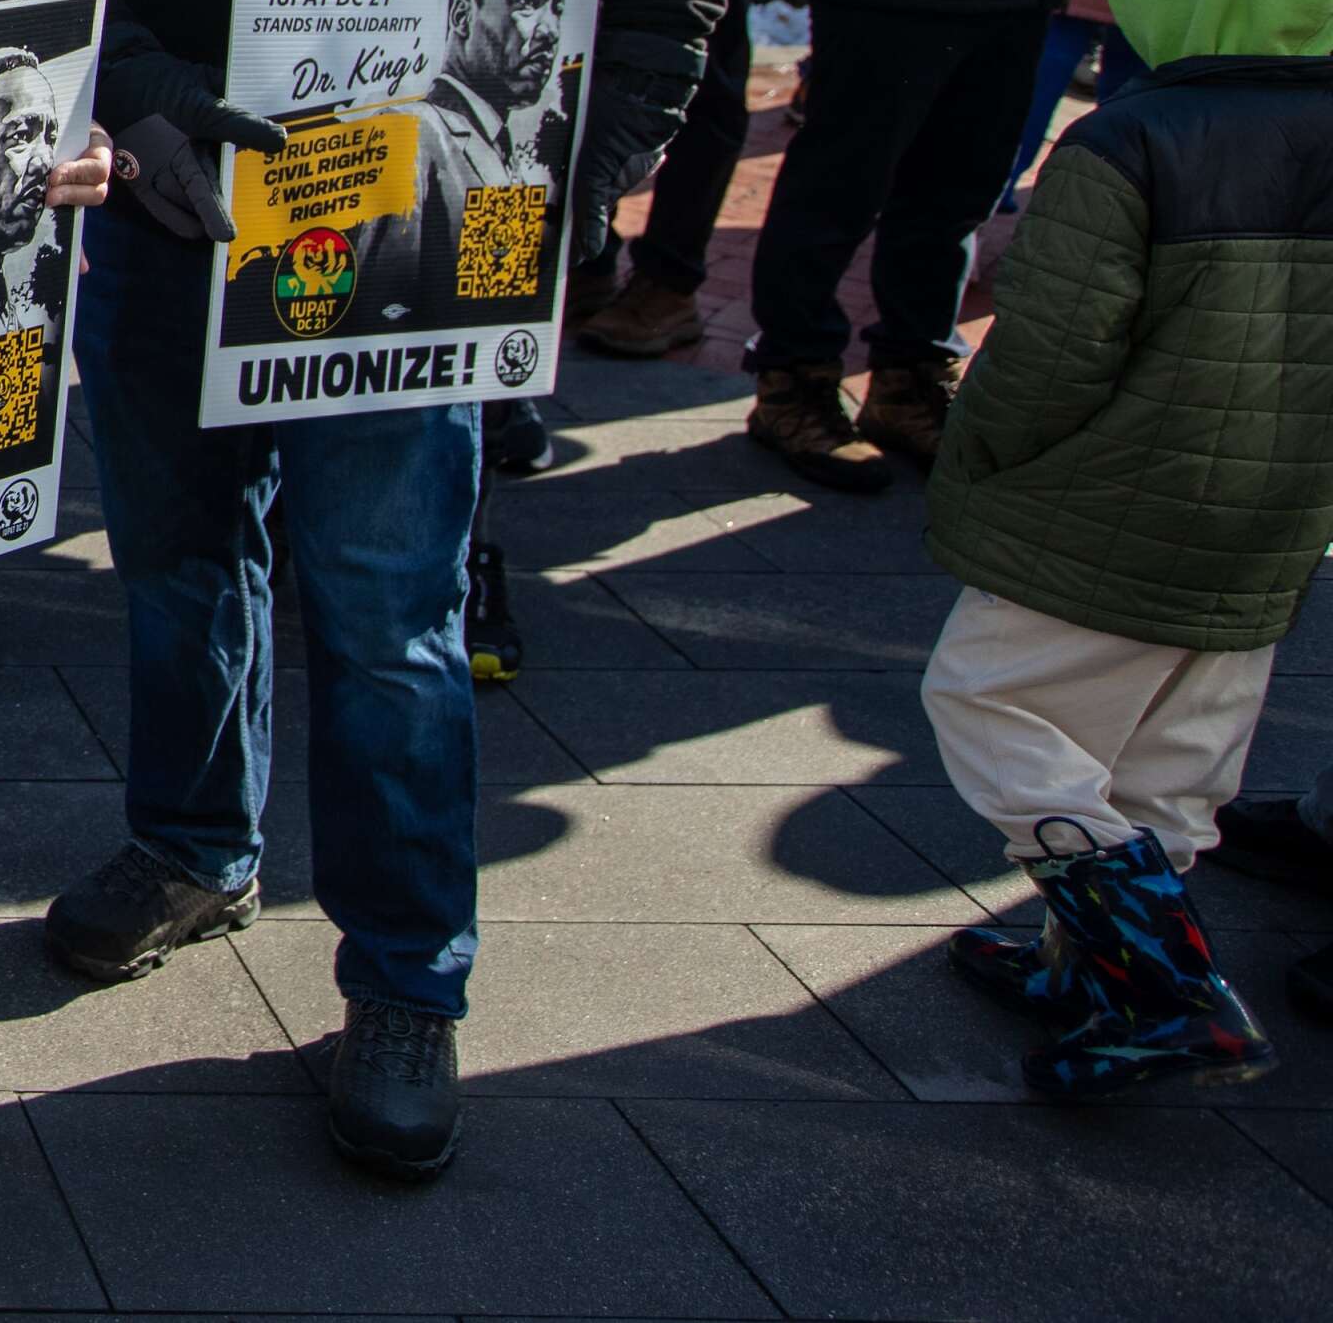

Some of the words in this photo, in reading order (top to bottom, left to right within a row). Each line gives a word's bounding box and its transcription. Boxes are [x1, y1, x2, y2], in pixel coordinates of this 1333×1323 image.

[253, 17, 314, 33] STANDS
[315, 17, 333, 33] IN
[336, 17, 422, 33] SOLIDARITY
[292, 58, 335, 100] Dr.
[347, 37, 428, 96] King's
[365, 126, 386, 153] for
[263, 165, 313, 186] CIVIL
[317, 145, 388, 175] RIGHTS
[267, 187, 281, 207] &
[282, 168, 383, 204] WORKERS'
[289, 193, 360, 223] RIGHTS
[290, 299, 336, 318] IUPAT
[297, 318, 312, 331] DC
[313, 317, 327, 330] 21
[238, 342, 477, 406] UNIONIZE!
